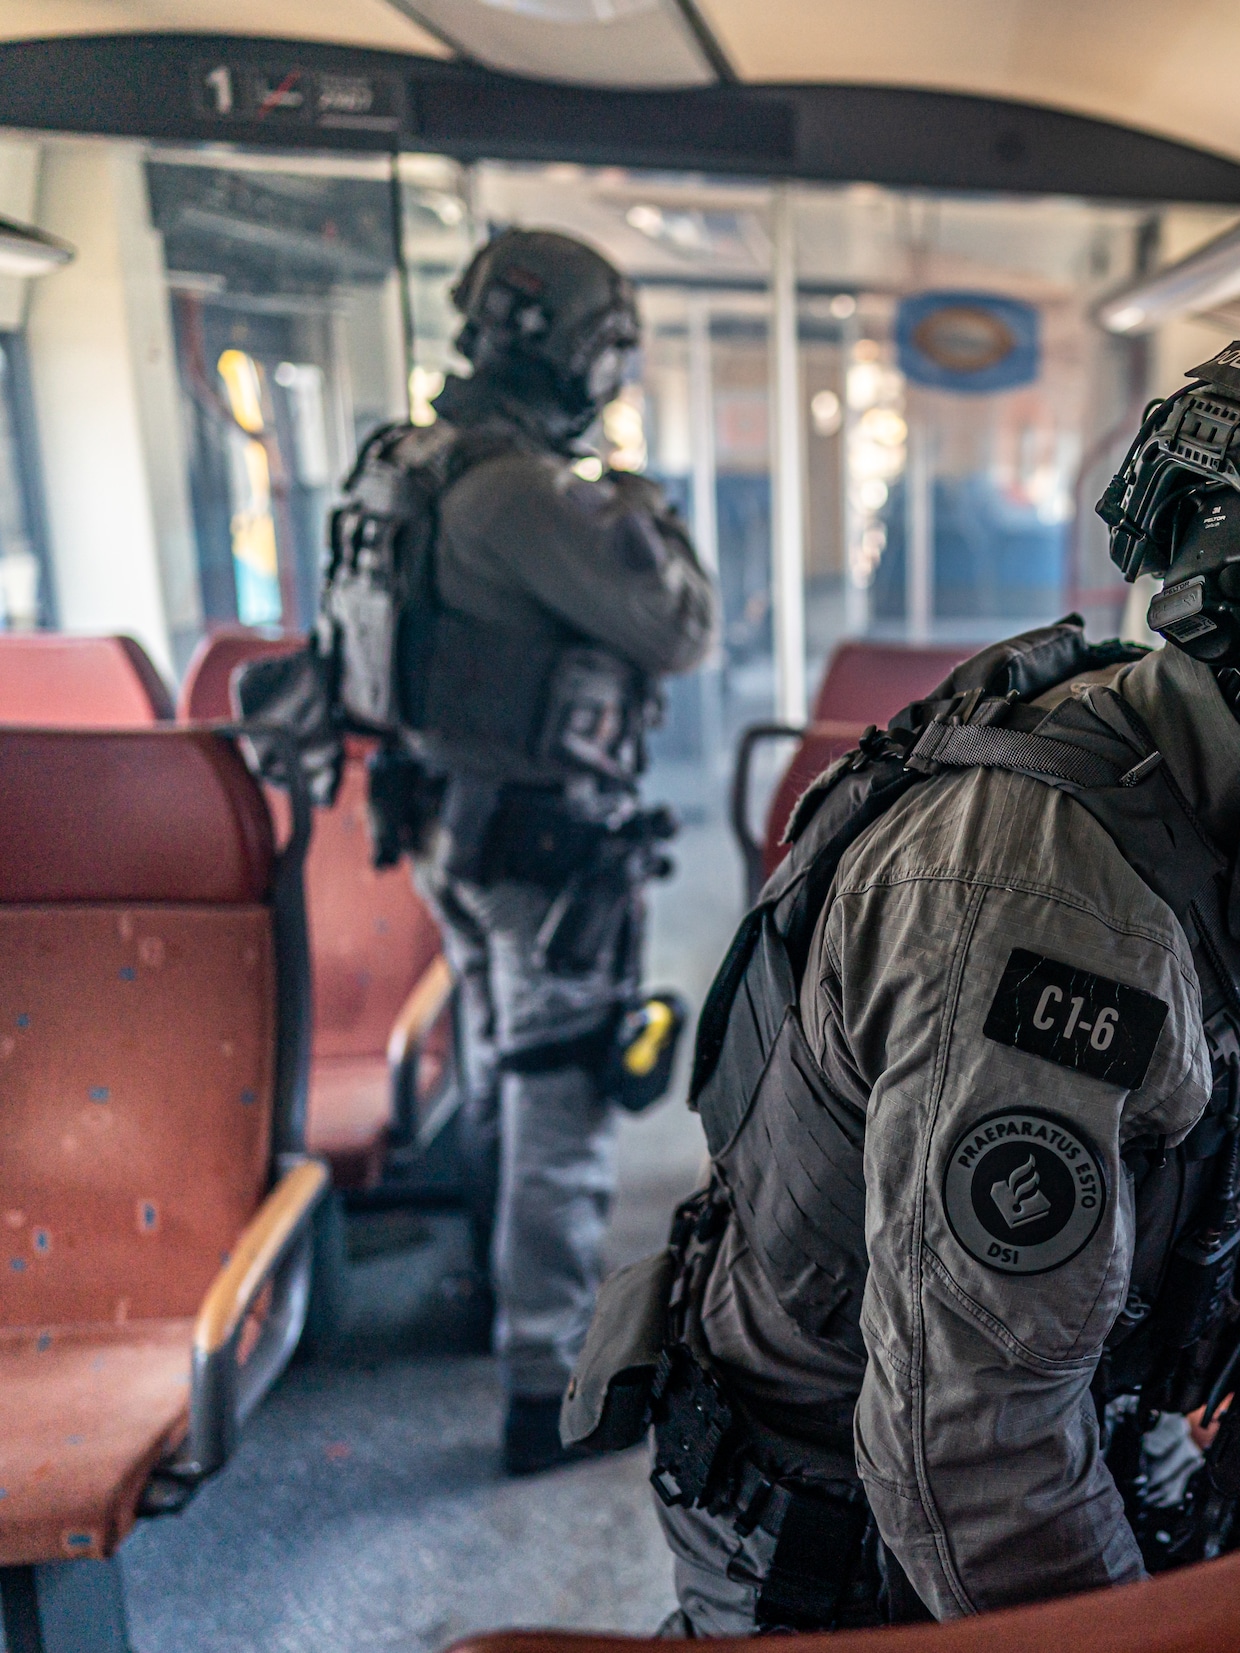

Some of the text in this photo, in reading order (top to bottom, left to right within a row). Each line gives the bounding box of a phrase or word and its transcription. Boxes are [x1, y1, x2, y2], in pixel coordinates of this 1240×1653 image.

[206, 66, 234, 115] 1
[1163, 581, 1191, 597] PELTOR
[957, 1120, 1096, 1209] PRAEPARATUS ESTO
[986, 1241, 1019, 1265] DSI
